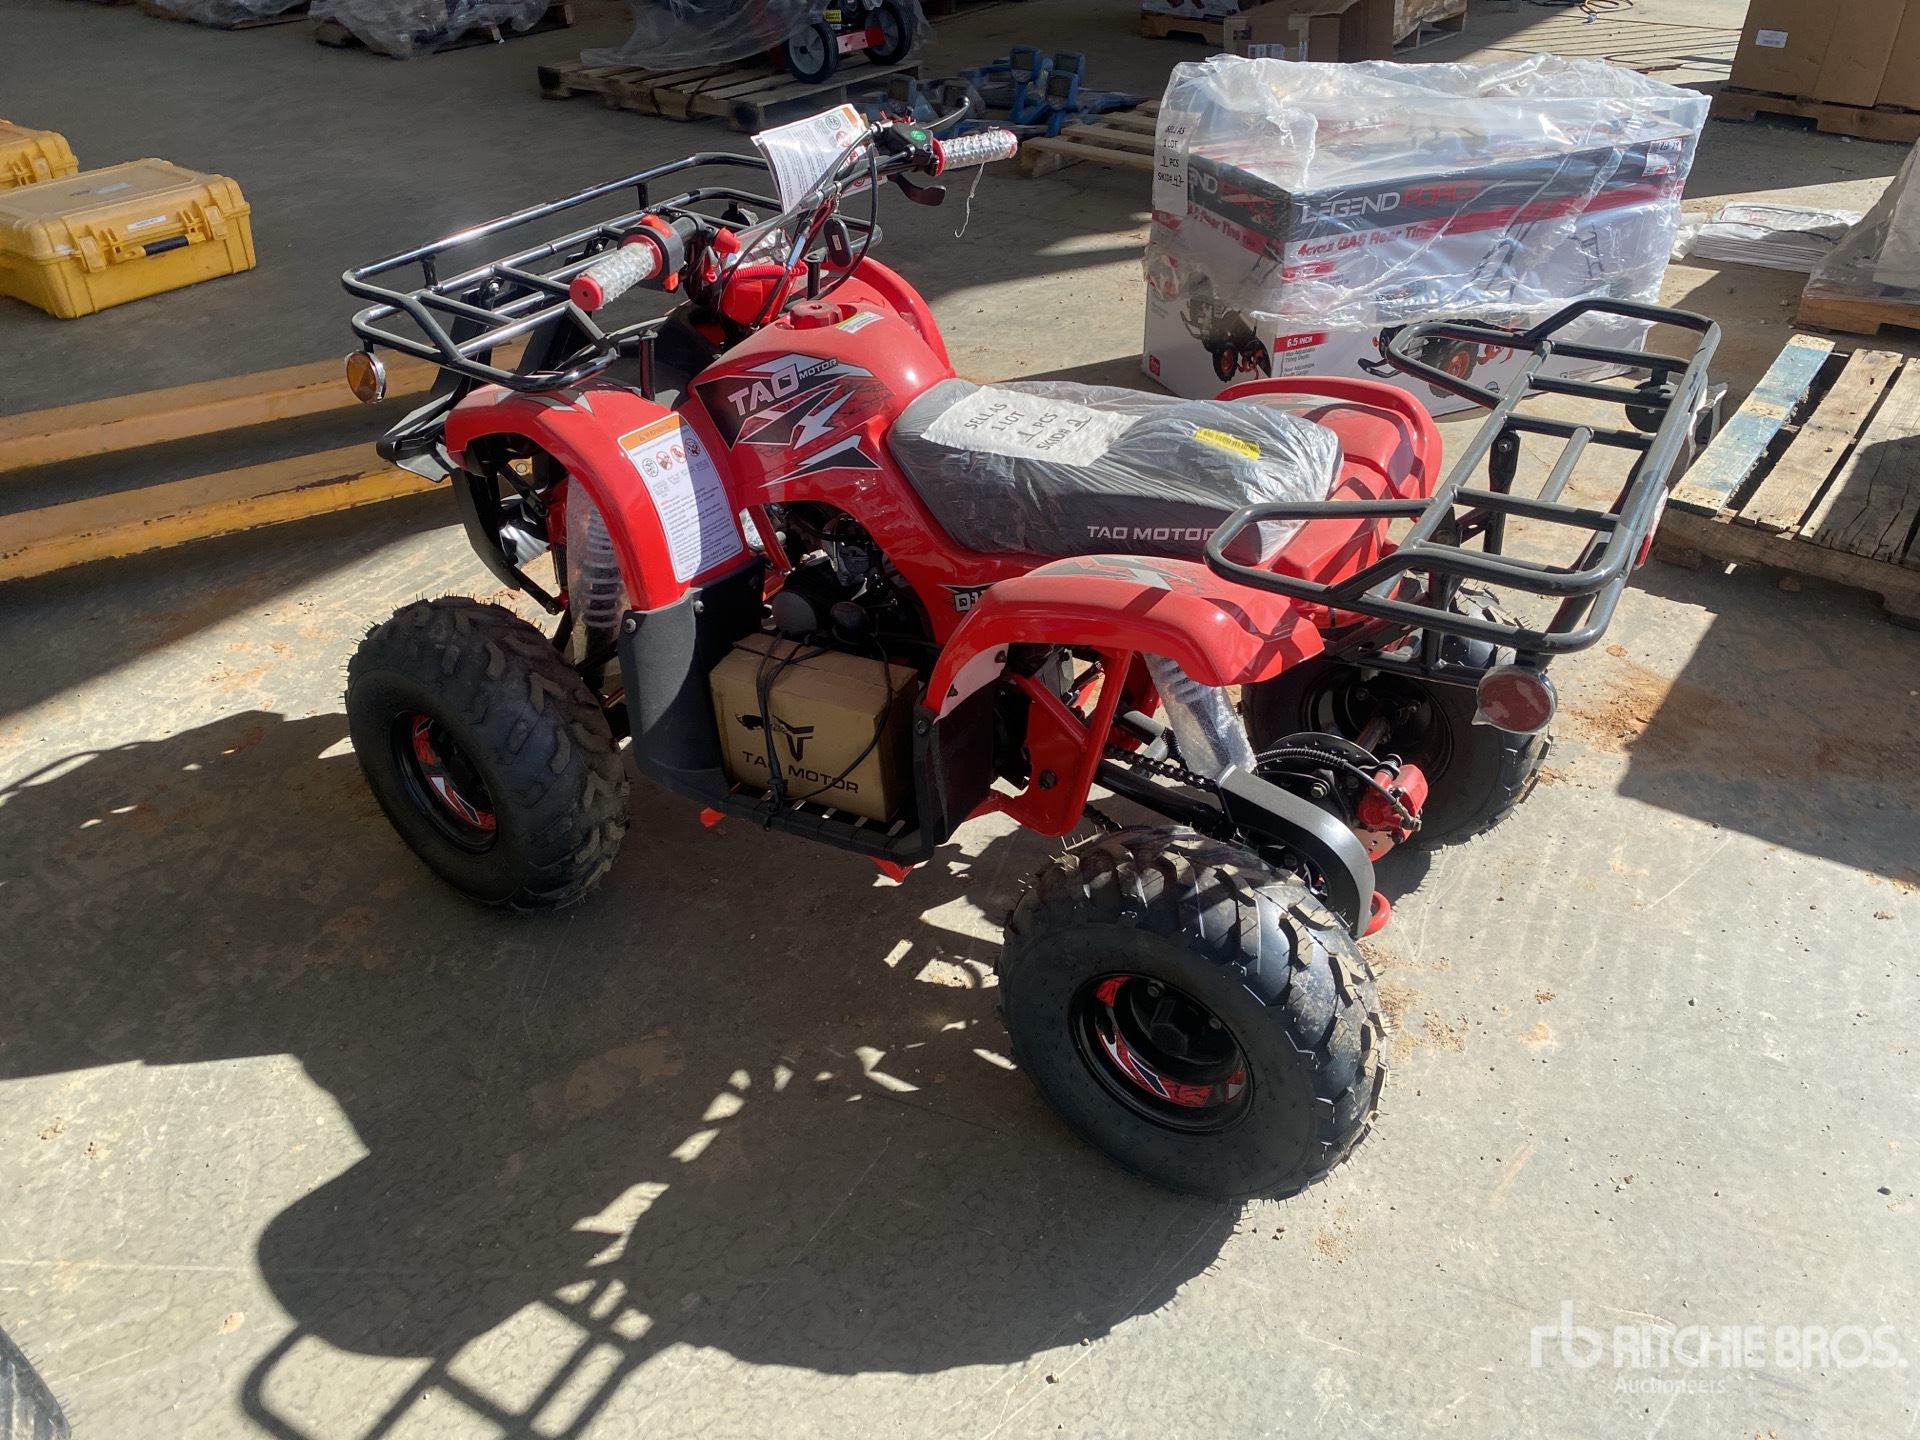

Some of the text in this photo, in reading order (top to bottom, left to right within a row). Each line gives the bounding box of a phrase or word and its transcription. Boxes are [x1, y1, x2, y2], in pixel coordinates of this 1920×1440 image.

[1176, 126, 1187, 136] AS
[1169, 157, 1180, 168] PCS
[1301, 192, 1401, 225] LEGEND
[1336, 233, 1368, 251] GAS
[1368, 229, 1402, 246] Rear
[1286, 335, 1313, 348] 6.5 INCH
[727, 358, 839, 416] TAO MOTOR
[964, 402, 1008, 430] SELL AS
[1000, 410, 1026, 426] LOT
[1032, 412, 1059, 429] PCS
[1036, 428, 1072, 451] SKID#
[1087, 525, 1129, 540] TAO
[742, 751, 860, 794] TA MOTOR
